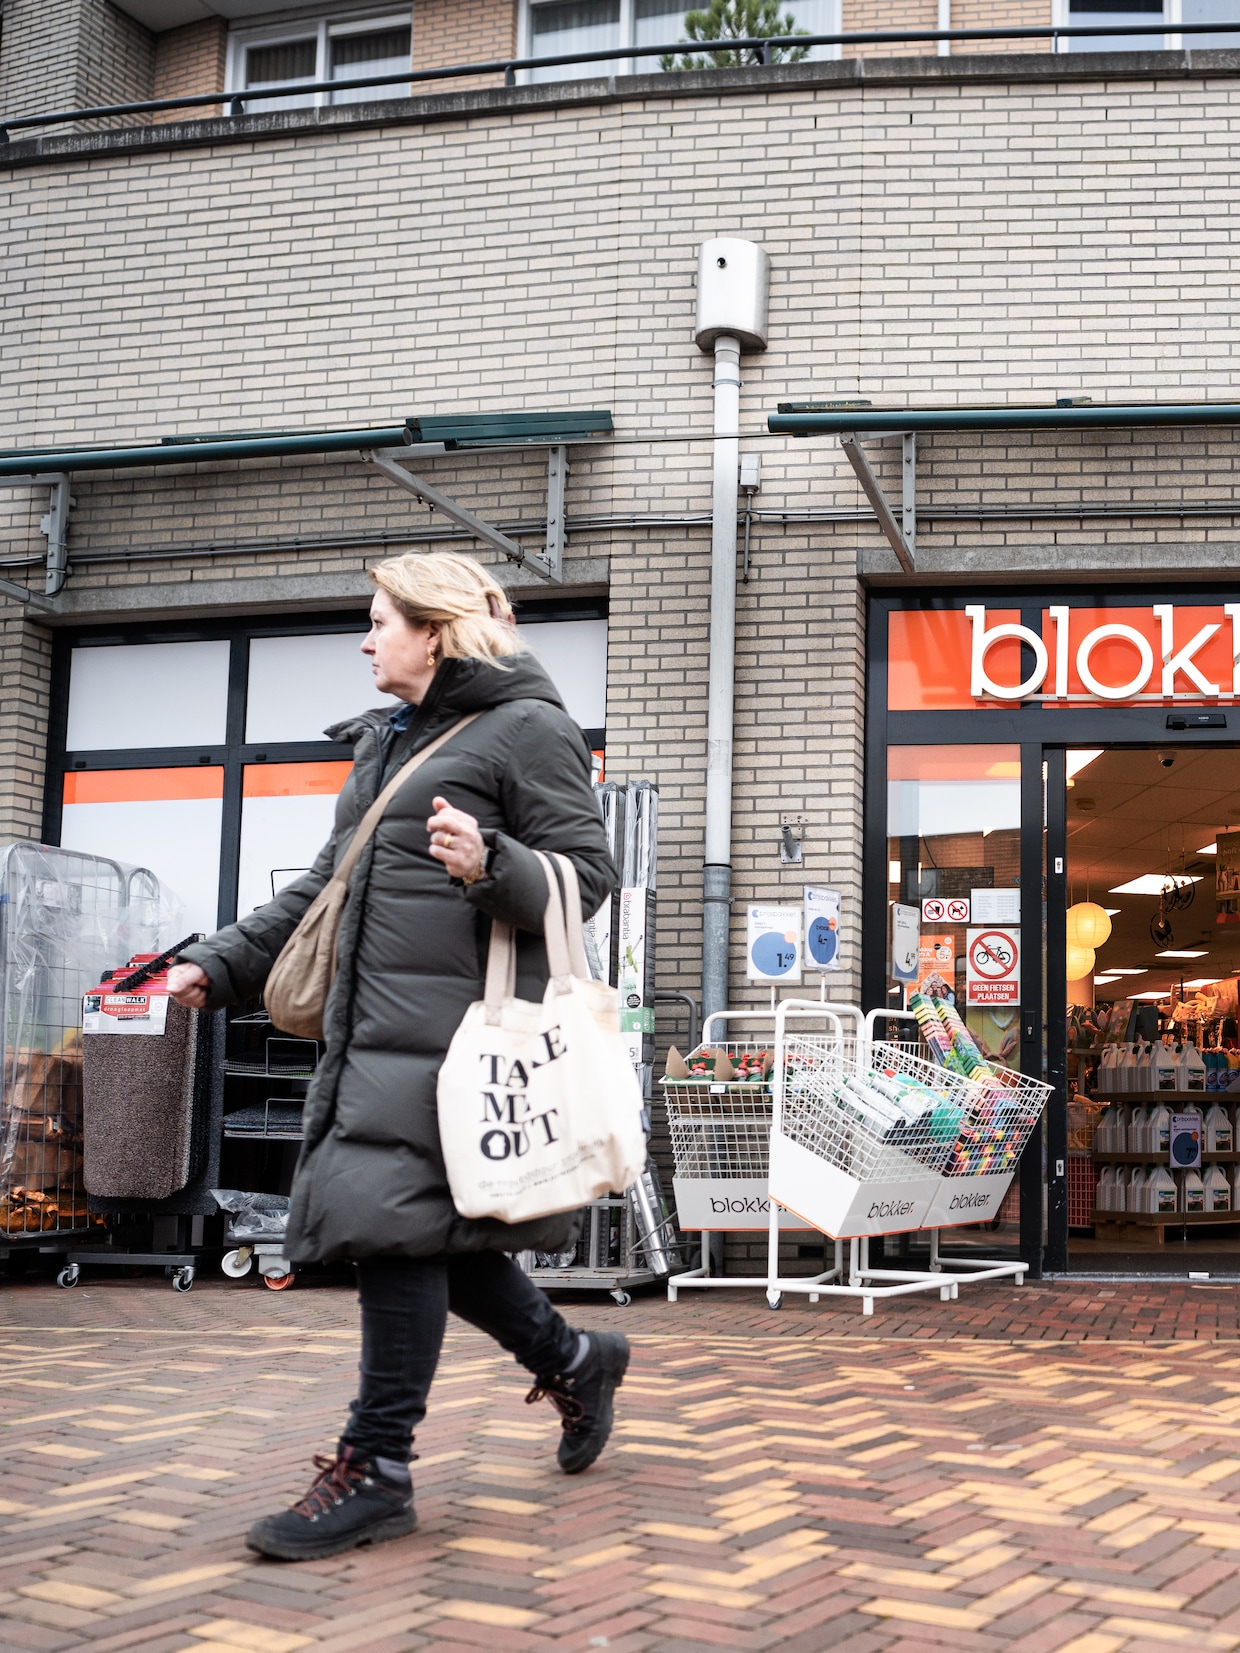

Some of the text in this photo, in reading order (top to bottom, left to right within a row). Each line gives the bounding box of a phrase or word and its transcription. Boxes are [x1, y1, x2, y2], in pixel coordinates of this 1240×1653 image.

[622, 900, 632, 940] brabantia
[989, 984, 1015, 992] FIETSEN
[480, 1107, 560, 1161] OUT
[709, 1197, 783, 1213] blokk
[867, 1199, 915, 1219] blokker.
[949, 1192, 991, 1210] blokker.
